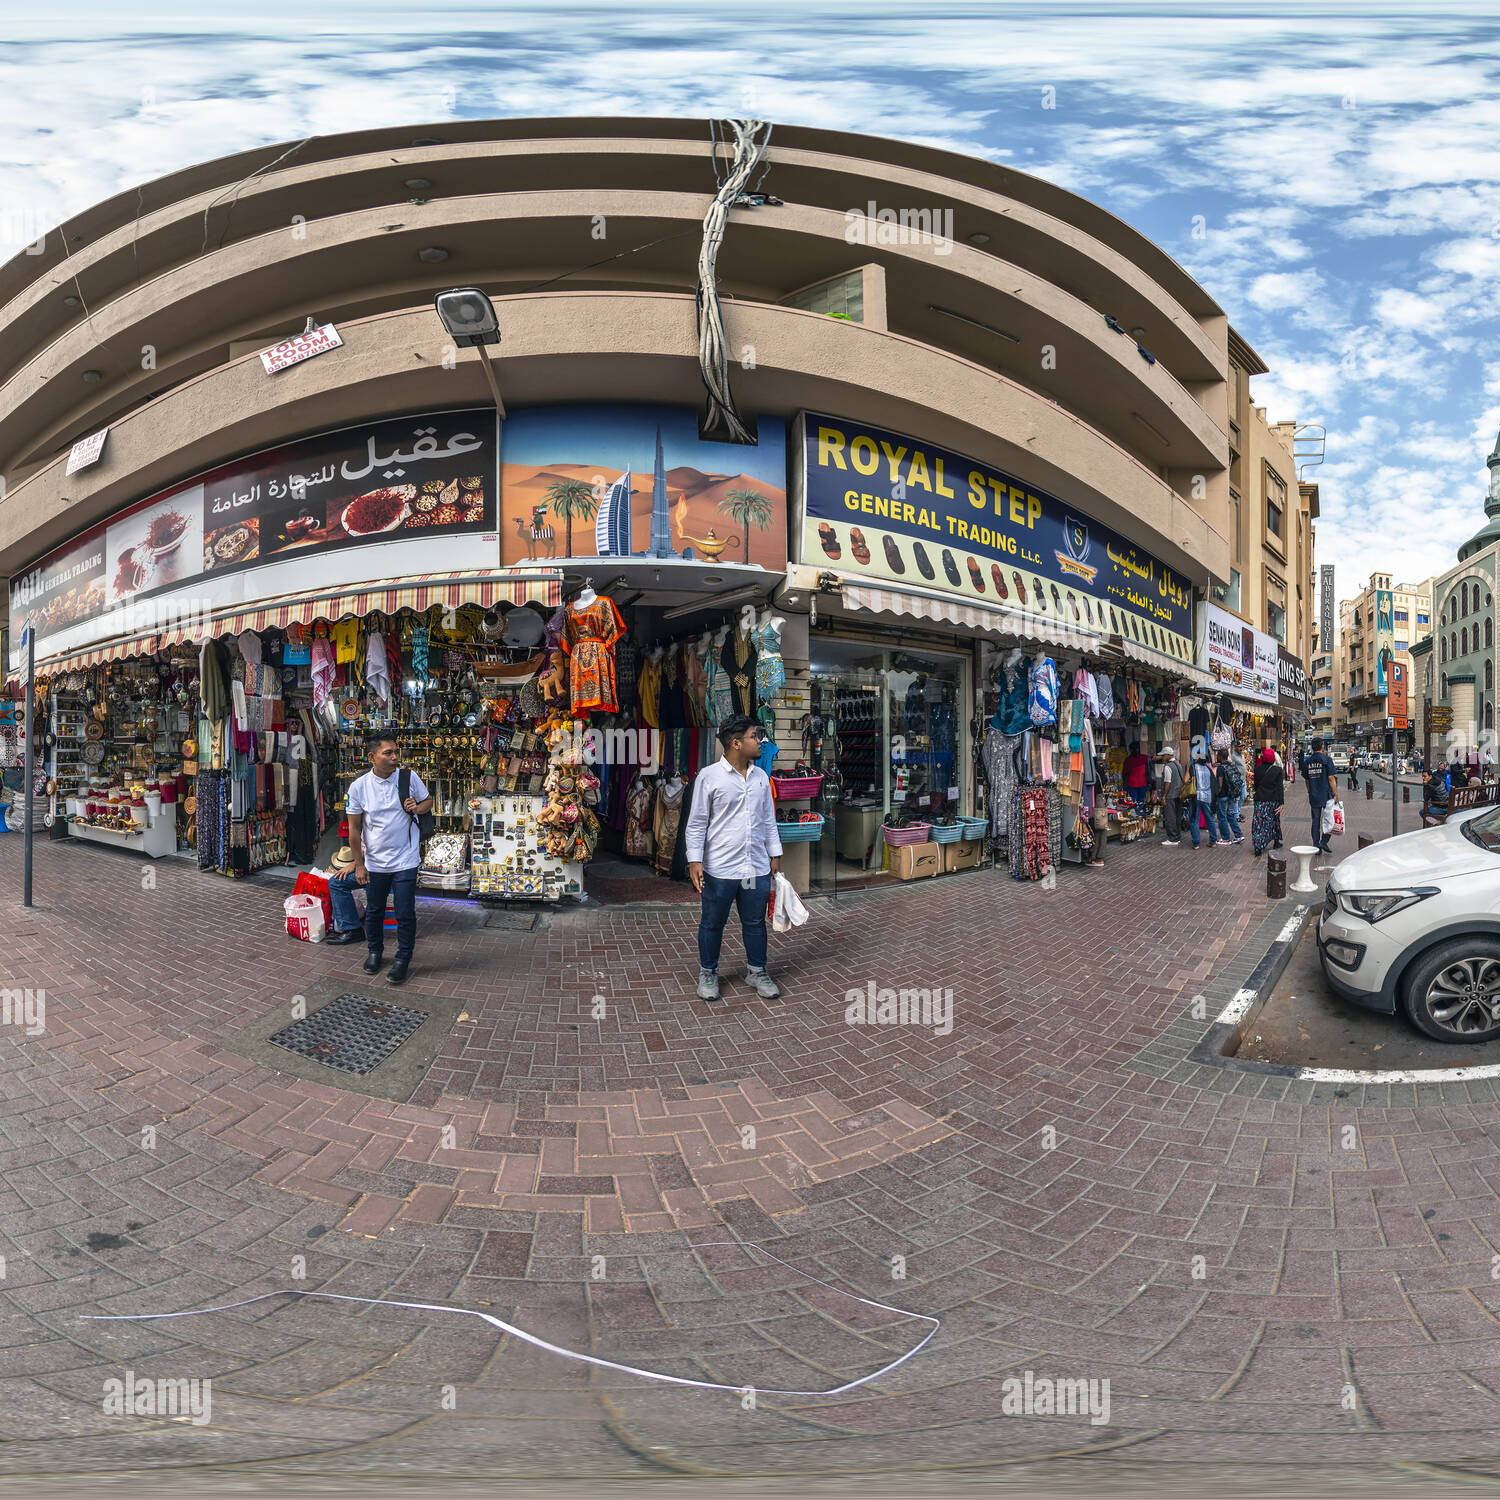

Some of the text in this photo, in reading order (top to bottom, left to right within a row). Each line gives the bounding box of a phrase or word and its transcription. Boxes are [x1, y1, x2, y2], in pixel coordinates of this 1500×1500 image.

[268, 361, 288, 373] 050
[270, 335, 329, 366] ROOM
[340, 427, 484, 480] عقيل
[211, 463, 336, 514] للتجارة العامة
[818, 427, 1043, 530] ROYAL STEP
[844, 490, 1044, 565] GENERAL TRADING L.L.C.
[13, 553, 102, 610] AQIL GENERAL TRADING
[1106, 542, 1188, 610] رويال استيب
[1127, 586, 1148, 609] العامة
[1209, 620, 1227, 646] SENAN
[1228, 629, 1241, 653] SONS
[1278, 658, 1294, 684] KING
[1394, 665, 1401, 680] P
